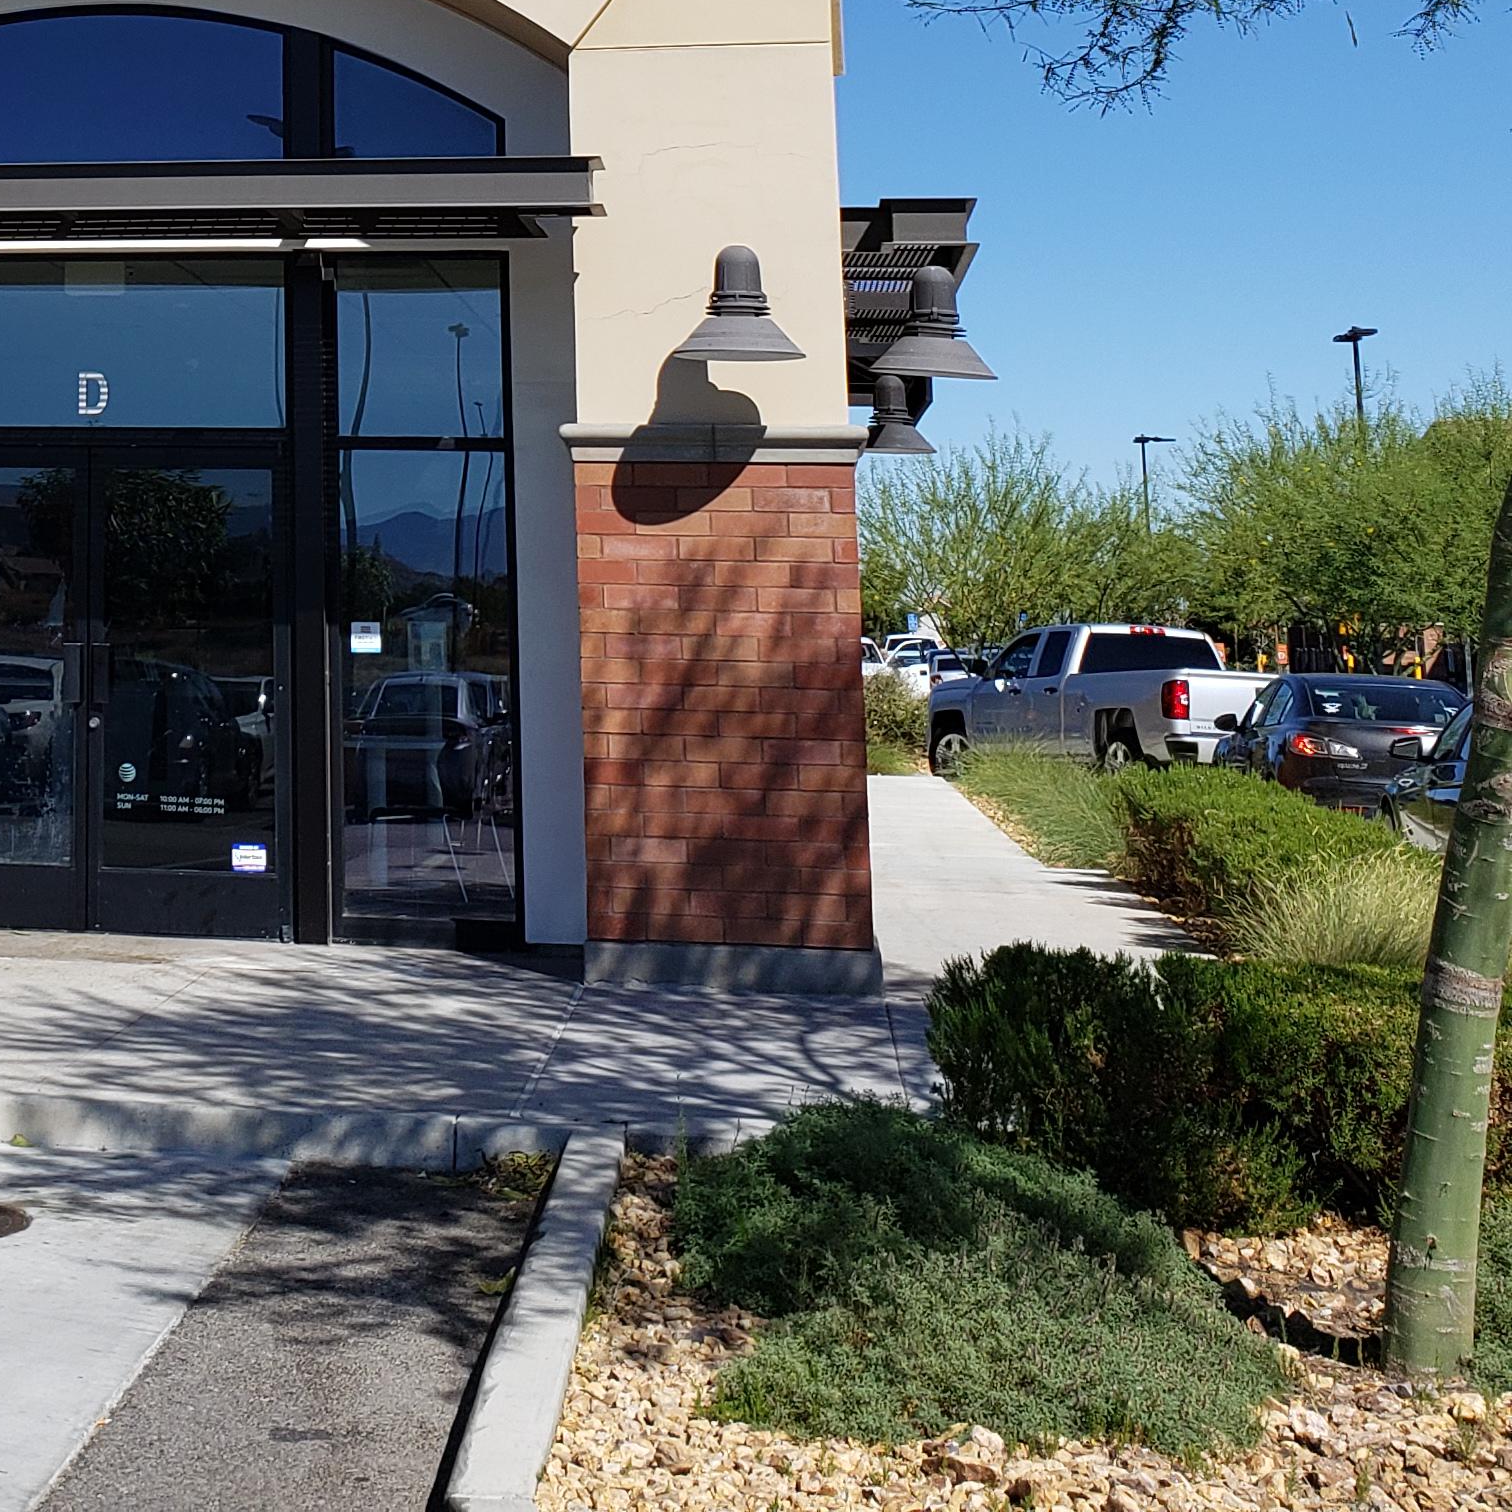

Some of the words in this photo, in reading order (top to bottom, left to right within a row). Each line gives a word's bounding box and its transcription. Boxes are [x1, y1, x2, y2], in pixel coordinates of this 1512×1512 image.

[78, 373, 108, 415] D
[116, 801, 132, 809] SUN
[177, 805, 189, 813] AM
[213, 807, 225, 815] PM
[177, 796, 189, 804] AM
[213, 798, 225, 806] PM
